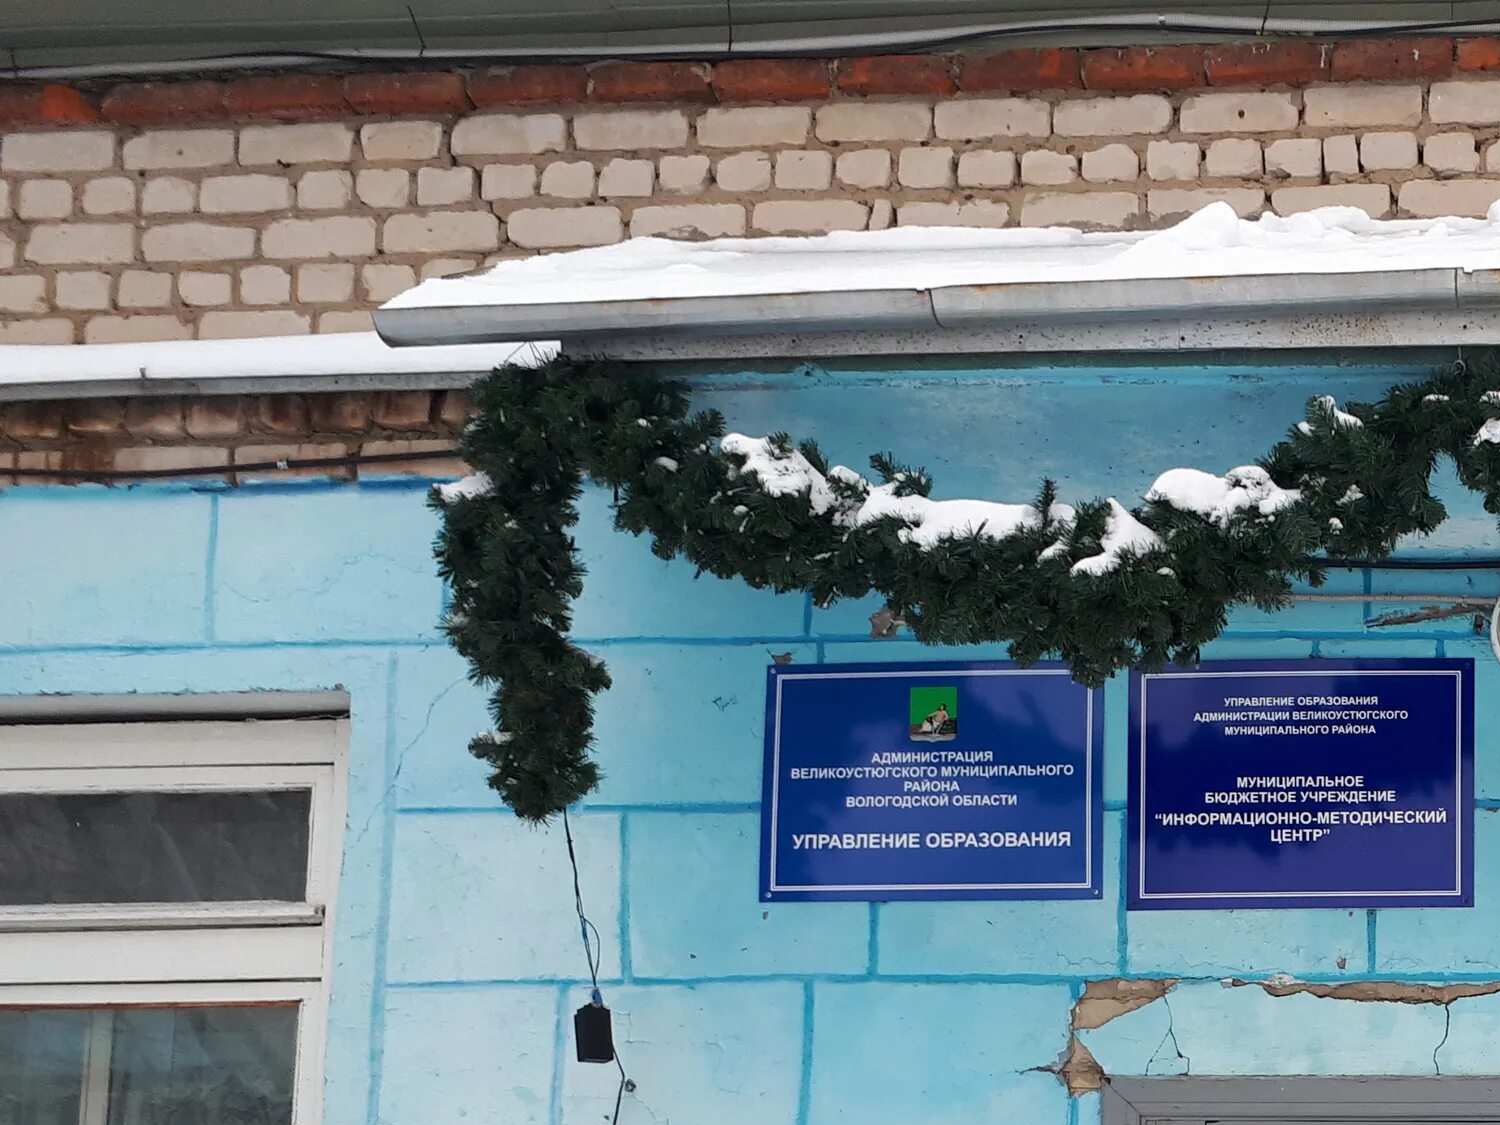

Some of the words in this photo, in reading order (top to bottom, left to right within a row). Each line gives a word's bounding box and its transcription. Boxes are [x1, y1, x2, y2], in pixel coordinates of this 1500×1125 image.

[1224, 697, 1295, 707] УПРАВЛЕНИЕ
[1297, 696, 1378, 706] ОБРАЗОВАНИЯ
[1194, 711, 1290, 722] АДМИНИСТРАЦИИ
[1293, 710, 1408, 720] ВЕЛИКОУСТЮГСКОГО
[1225, 725, 1329, 736] МУНИЦИПАЛЬНОГО
[1332, 724, 1376, 734] РАЙОНА
[871, 751, 993, 765] АДМИНИСТРАЦИЯ
[791, 766, 938, 779] ВЕЛИКОУСТЮГСКОГО
[941, 765, 1074, 778] МУНИЦИПАЛЬНОГО
[904, 780, 960, 792] РАЙОНА
[1237, 776, 1364, 789] МУНИЦИПАЛЬНОЕ
[846, 794, 949, 808] ВОЛОГОДСКОЙ
[953, 795, 1017, 806] ОБЛАСТИ
[1205, 792, 1296, 805] БЮДЖЕТНОЕ
[1301, 791, 1396, 804] УЧРЕЖДЕНИЕ
[792, 833, 920, 849] УПРАВЛЕНИЕ
[926, 831, 1071, 848] ОБРАЗОВАНИЯ
